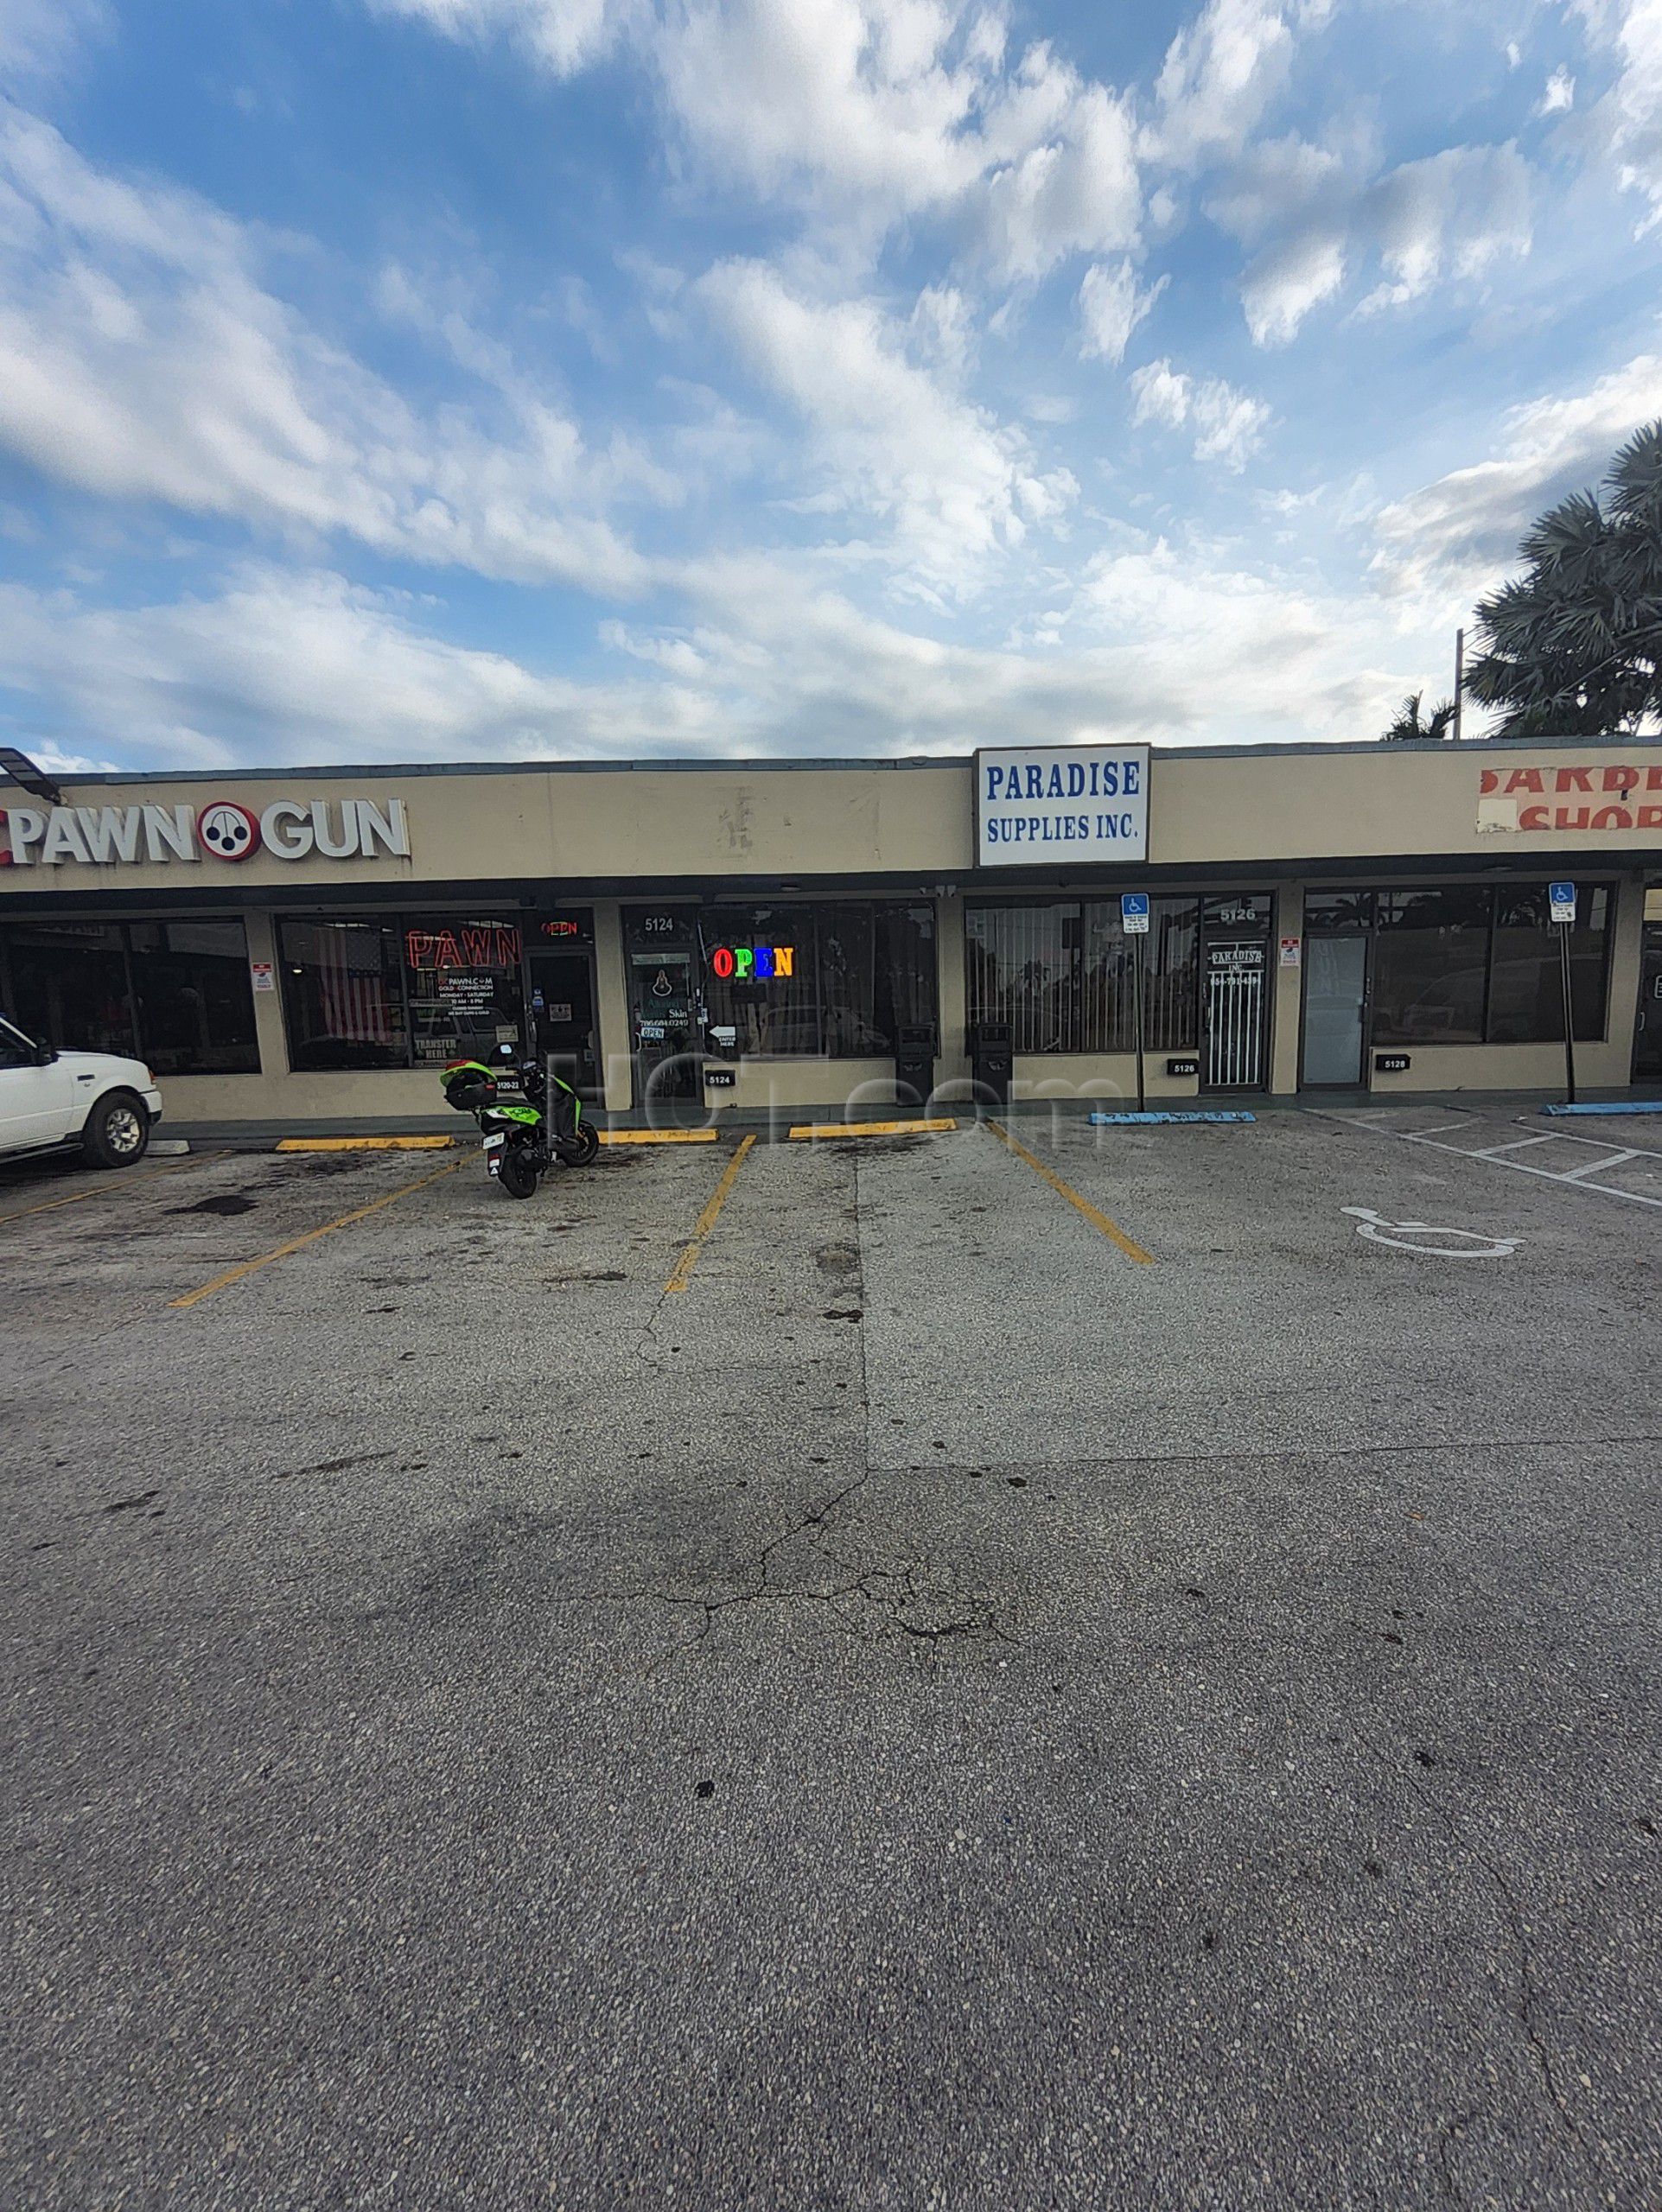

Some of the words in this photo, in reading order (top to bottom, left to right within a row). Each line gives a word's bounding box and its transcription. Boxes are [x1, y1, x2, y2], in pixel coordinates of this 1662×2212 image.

[987, 761, 1139, 800] PARADISE
[6, 804, 202, 864] PAWN
[260, 798, 411, 860] GUN
[988, 816, 1089, 842] SUPPLIES
[1096, 813, 1138, 838] INC.
[1220, 909, 1256, 920] 5126
[645, 918, 673, 931] 5124
[408, 929, 522, 969] PAWN
[713, 947, 794, 977] OPEN
[1212, 950, 1261, 963] PARADISE
[669, 1008, 688, 1019] Skin
[643, 1028, 663, 1037] OPEN
[415, 1039, 456, 1049] TRANSFER
[426, 1049, 448, 1058] HERE
